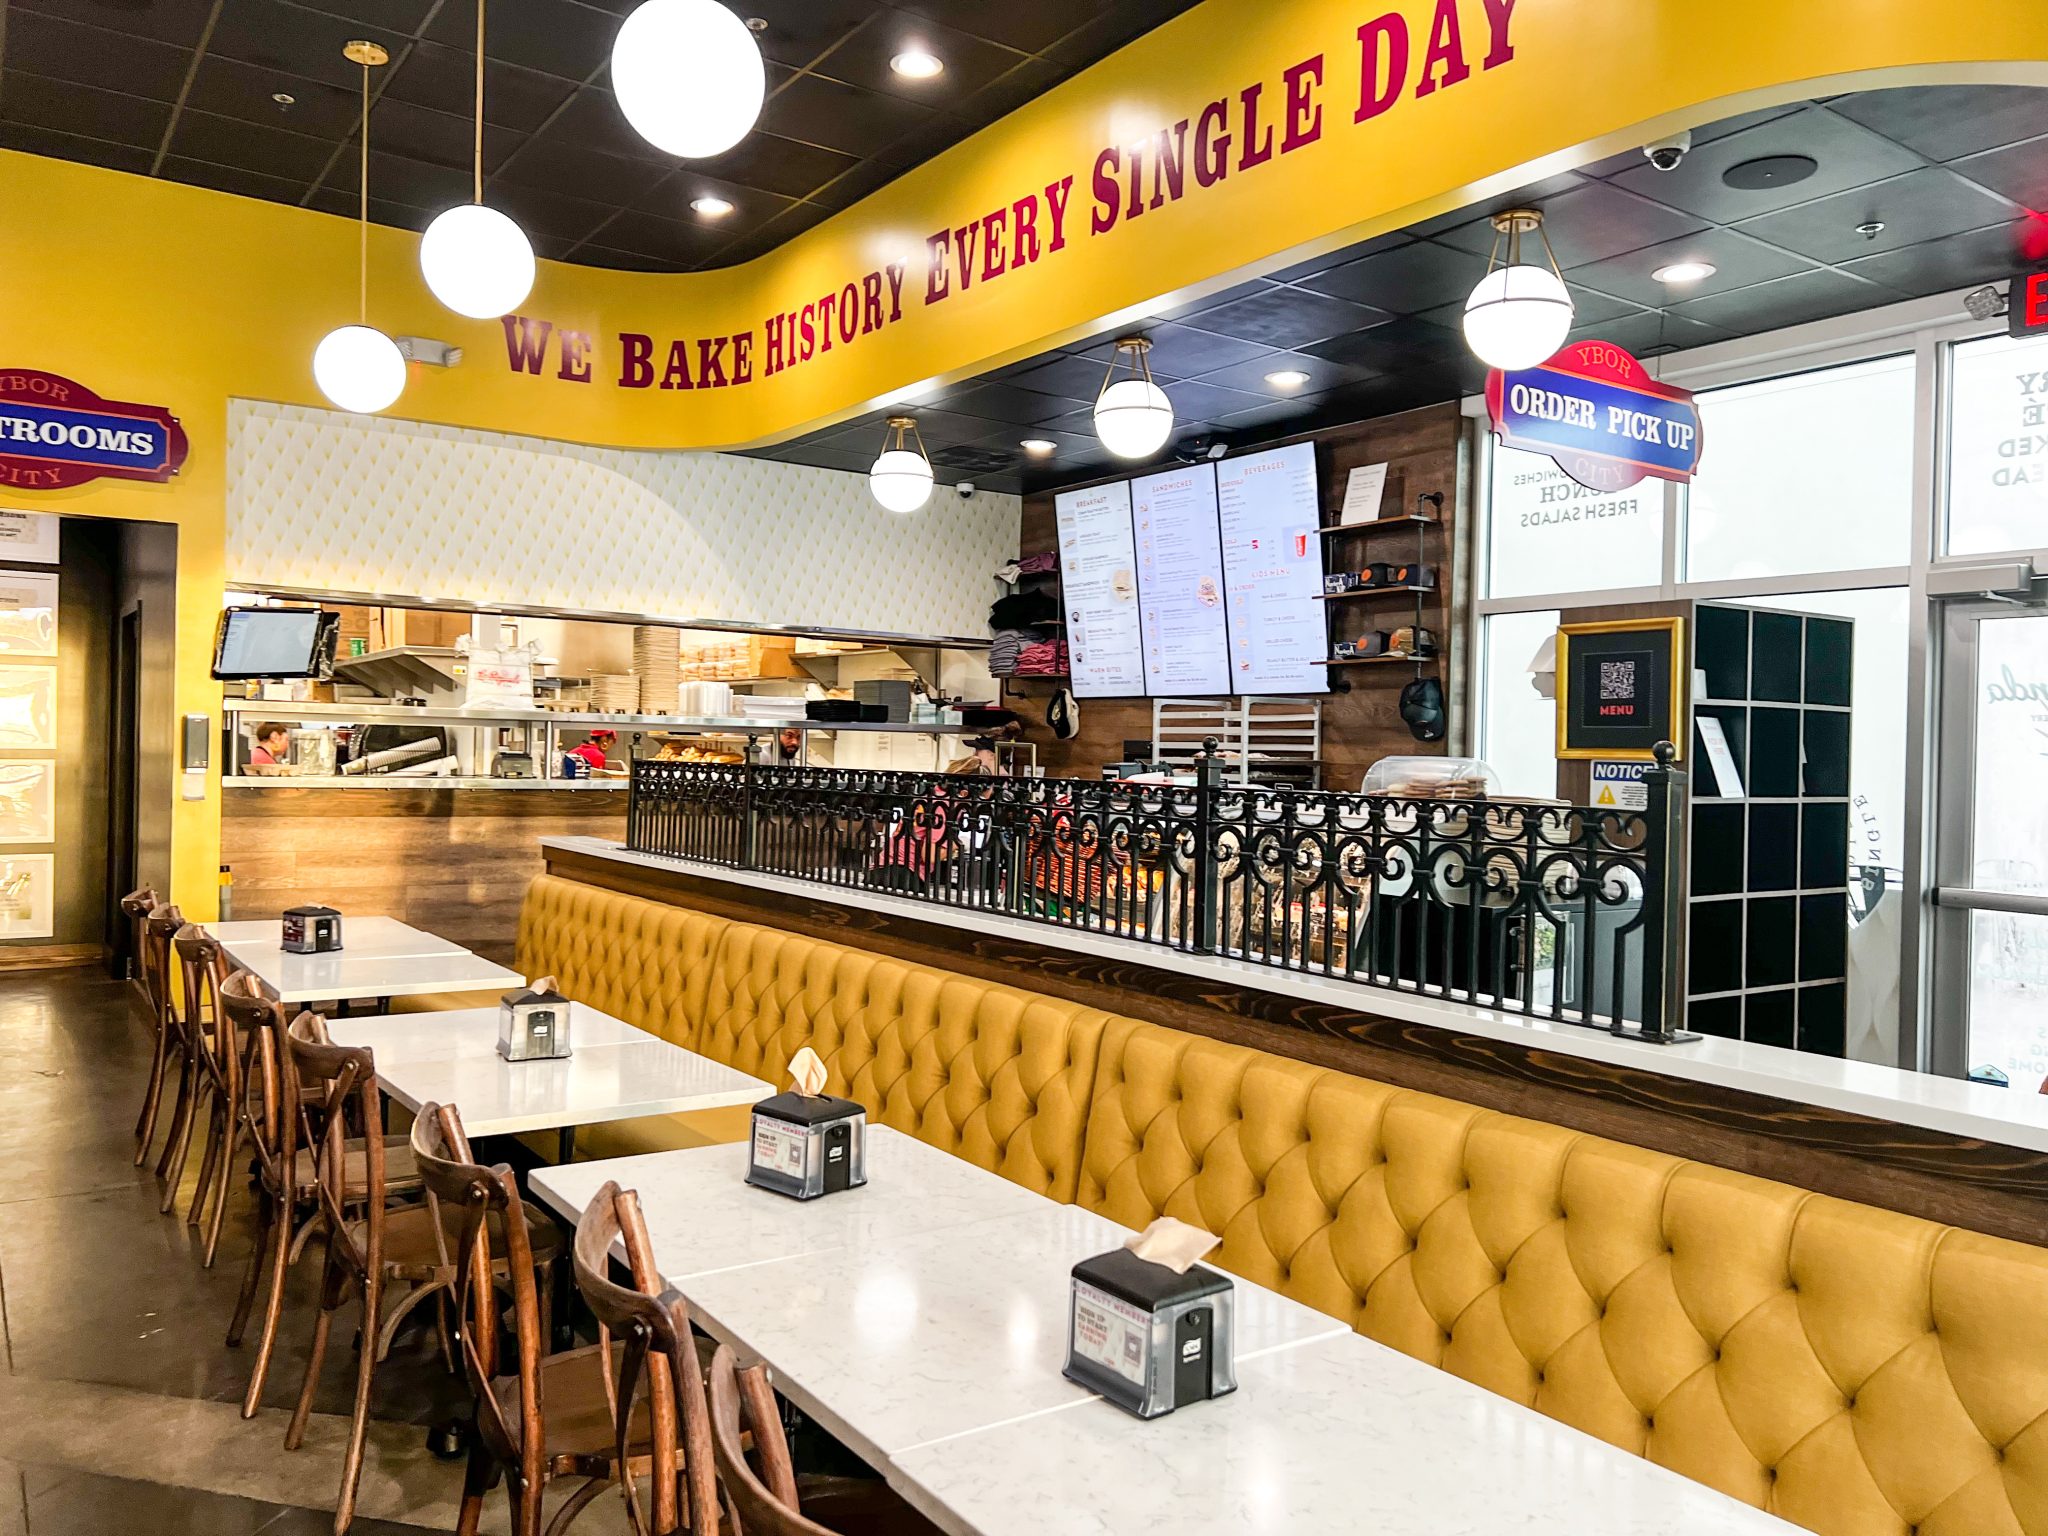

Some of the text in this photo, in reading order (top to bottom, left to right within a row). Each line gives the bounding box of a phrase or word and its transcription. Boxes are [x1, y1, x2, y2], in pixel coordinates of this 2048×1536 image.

[501, 0, 1516, 390] WE BAKE HISTORY EVERY SINGLE DAY
[1577, 346, 1631, 379] YBOR
[1510, 384, 1694, 451] ORDER PICK UP
[1244, 461, 1285, 475] BEVERAGES
[1575, 457, 1625, 484] CITY
[1152, 480, 1192, 492] SANDWICHES
[1076, 496, 1107, 508] BREAKFAST
[1270, 567, 1290, 576] MENU
[1600, 705, 1633, 715] MENU
